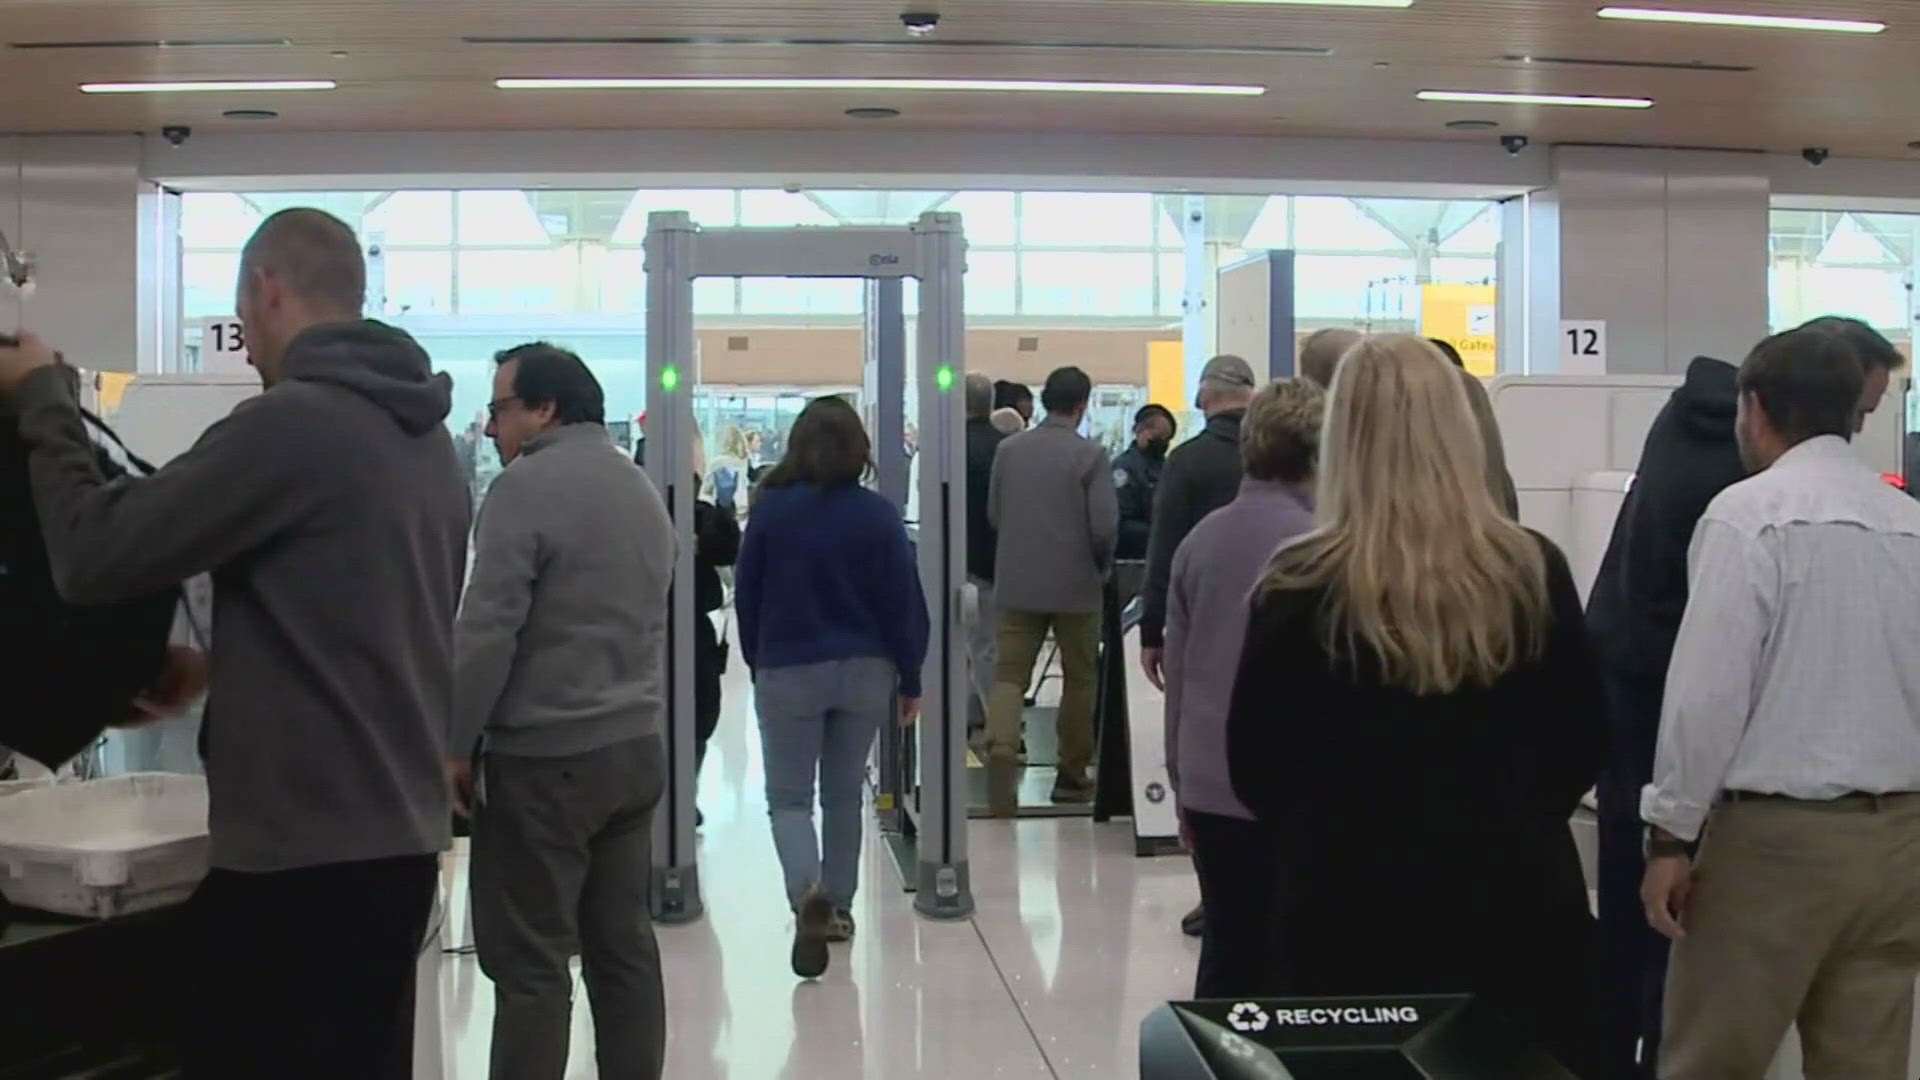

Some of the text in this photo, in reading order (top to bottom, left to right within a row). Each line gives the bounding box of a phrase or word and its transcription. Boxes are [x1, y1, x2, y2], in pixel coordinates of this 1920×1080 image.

[210, 323, 244, 352] 13
[1567, 329, 1599, 355] 12
[1275, 1006, 1419, 1025] RECYCLING
